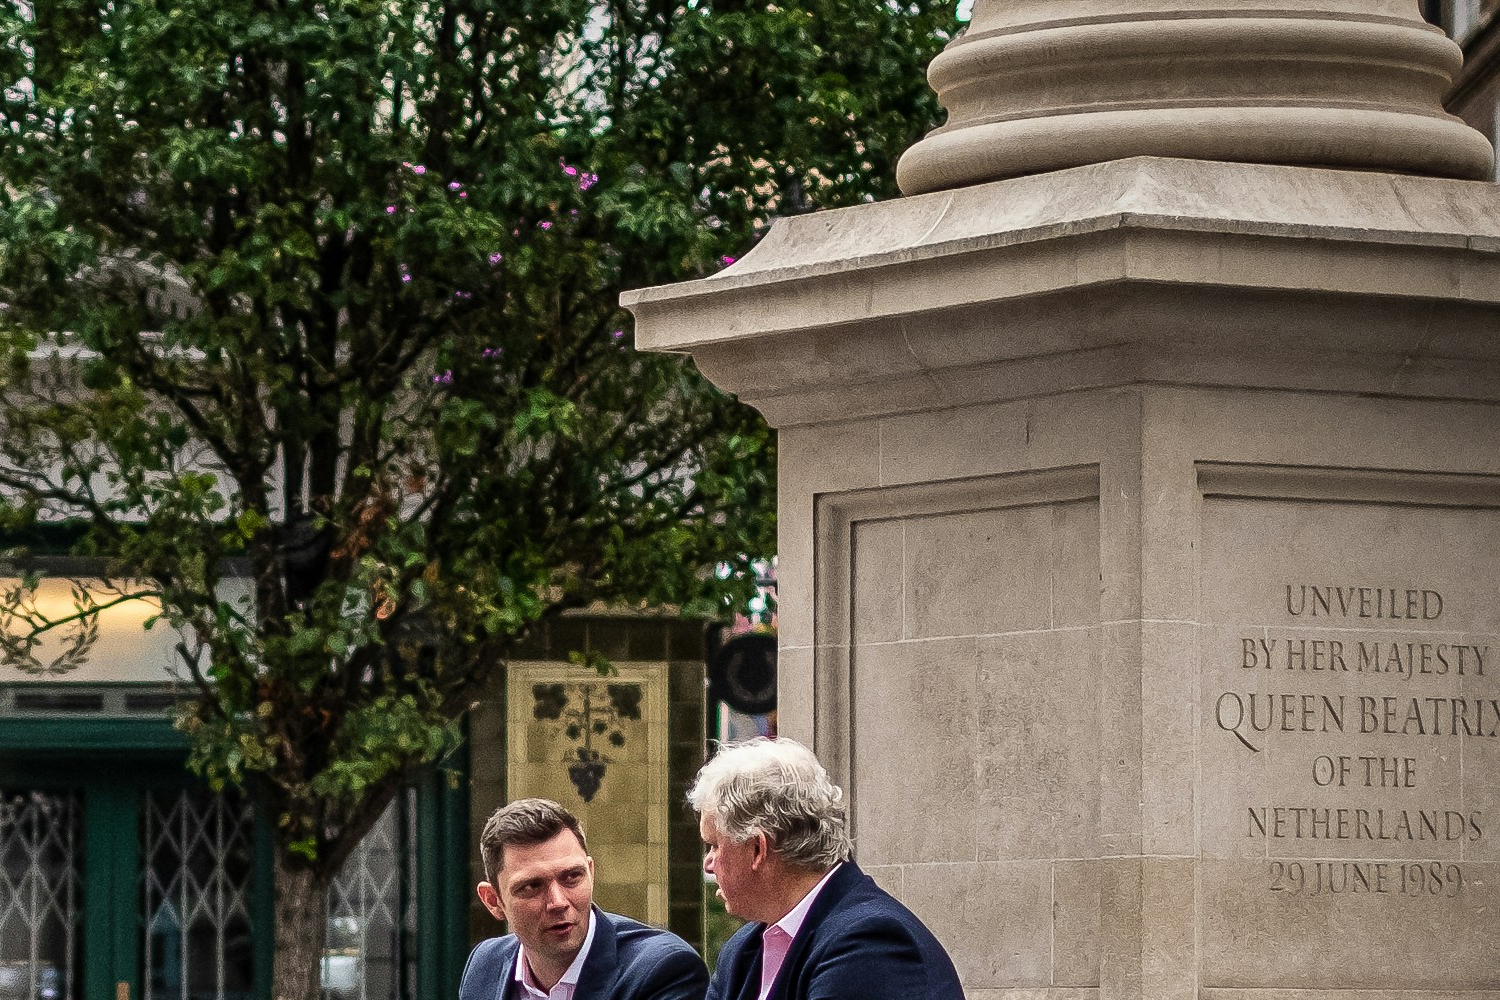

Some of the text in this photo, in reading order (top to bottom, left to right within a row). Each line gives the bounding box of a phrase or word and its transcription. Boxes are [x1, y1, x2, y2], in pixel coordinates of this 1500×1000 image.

[1286, 584, 1443, 620] UNVEILED
[1241, 638, 1489, 682] BY HER MAJESTY
[1215, 691, 1345, 753] QUEEN
[1312, 755, 1417, 788] OF THE
[1246, 806, 1483, 842] NETHERLANDS
[1269, 860, 1463, 898] 29 JUNE 1989
